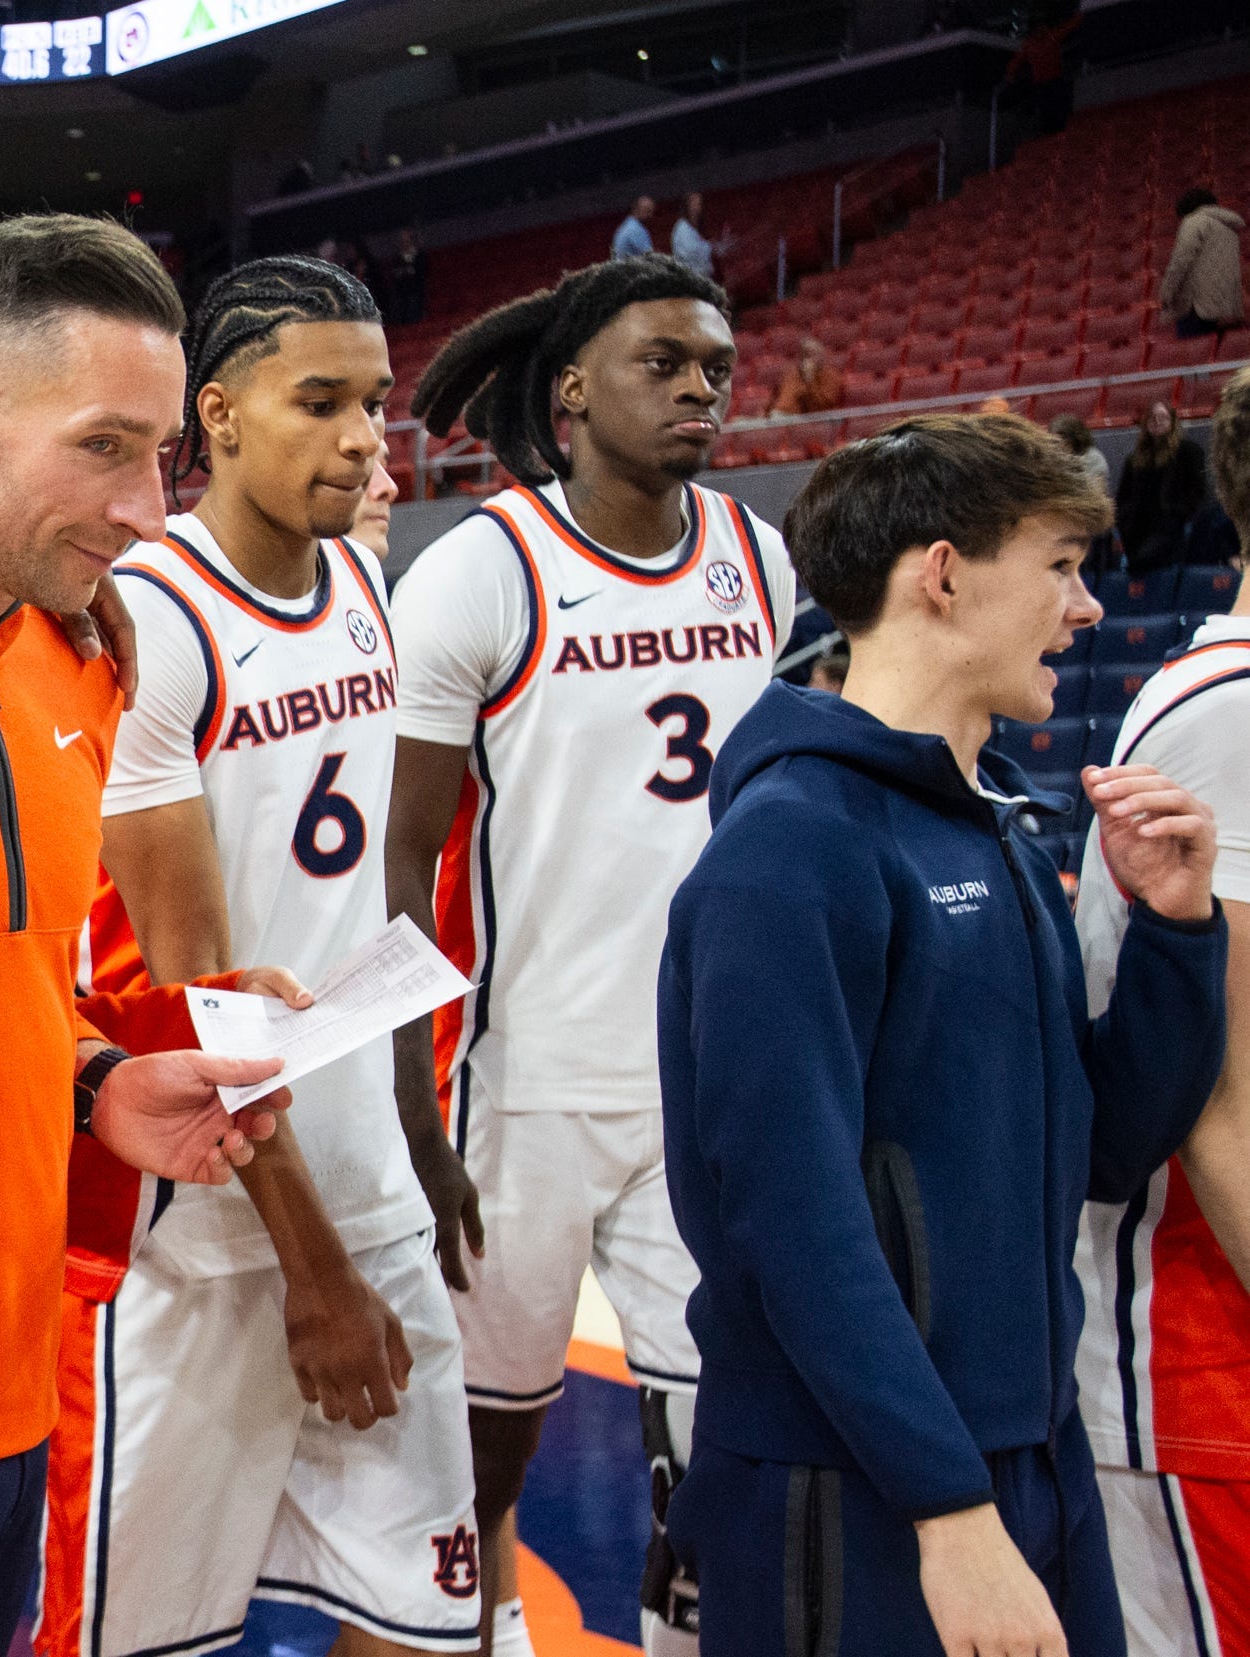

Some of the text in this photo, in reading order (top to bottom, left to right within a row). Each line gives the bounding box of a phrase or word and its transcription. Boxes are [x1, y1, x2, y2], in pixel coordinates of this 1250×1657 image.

[707, 561, 742, 601] SEC
[347, 610, 377, 653] SEC
[552, 622, 763, 674] AUBURN
[219, 667, 397, 751] AUBURN
[644, 691, 714, 804] 3
[291, 751, 367, 879] 6
[928, 880, 990, 904] AUBURN
